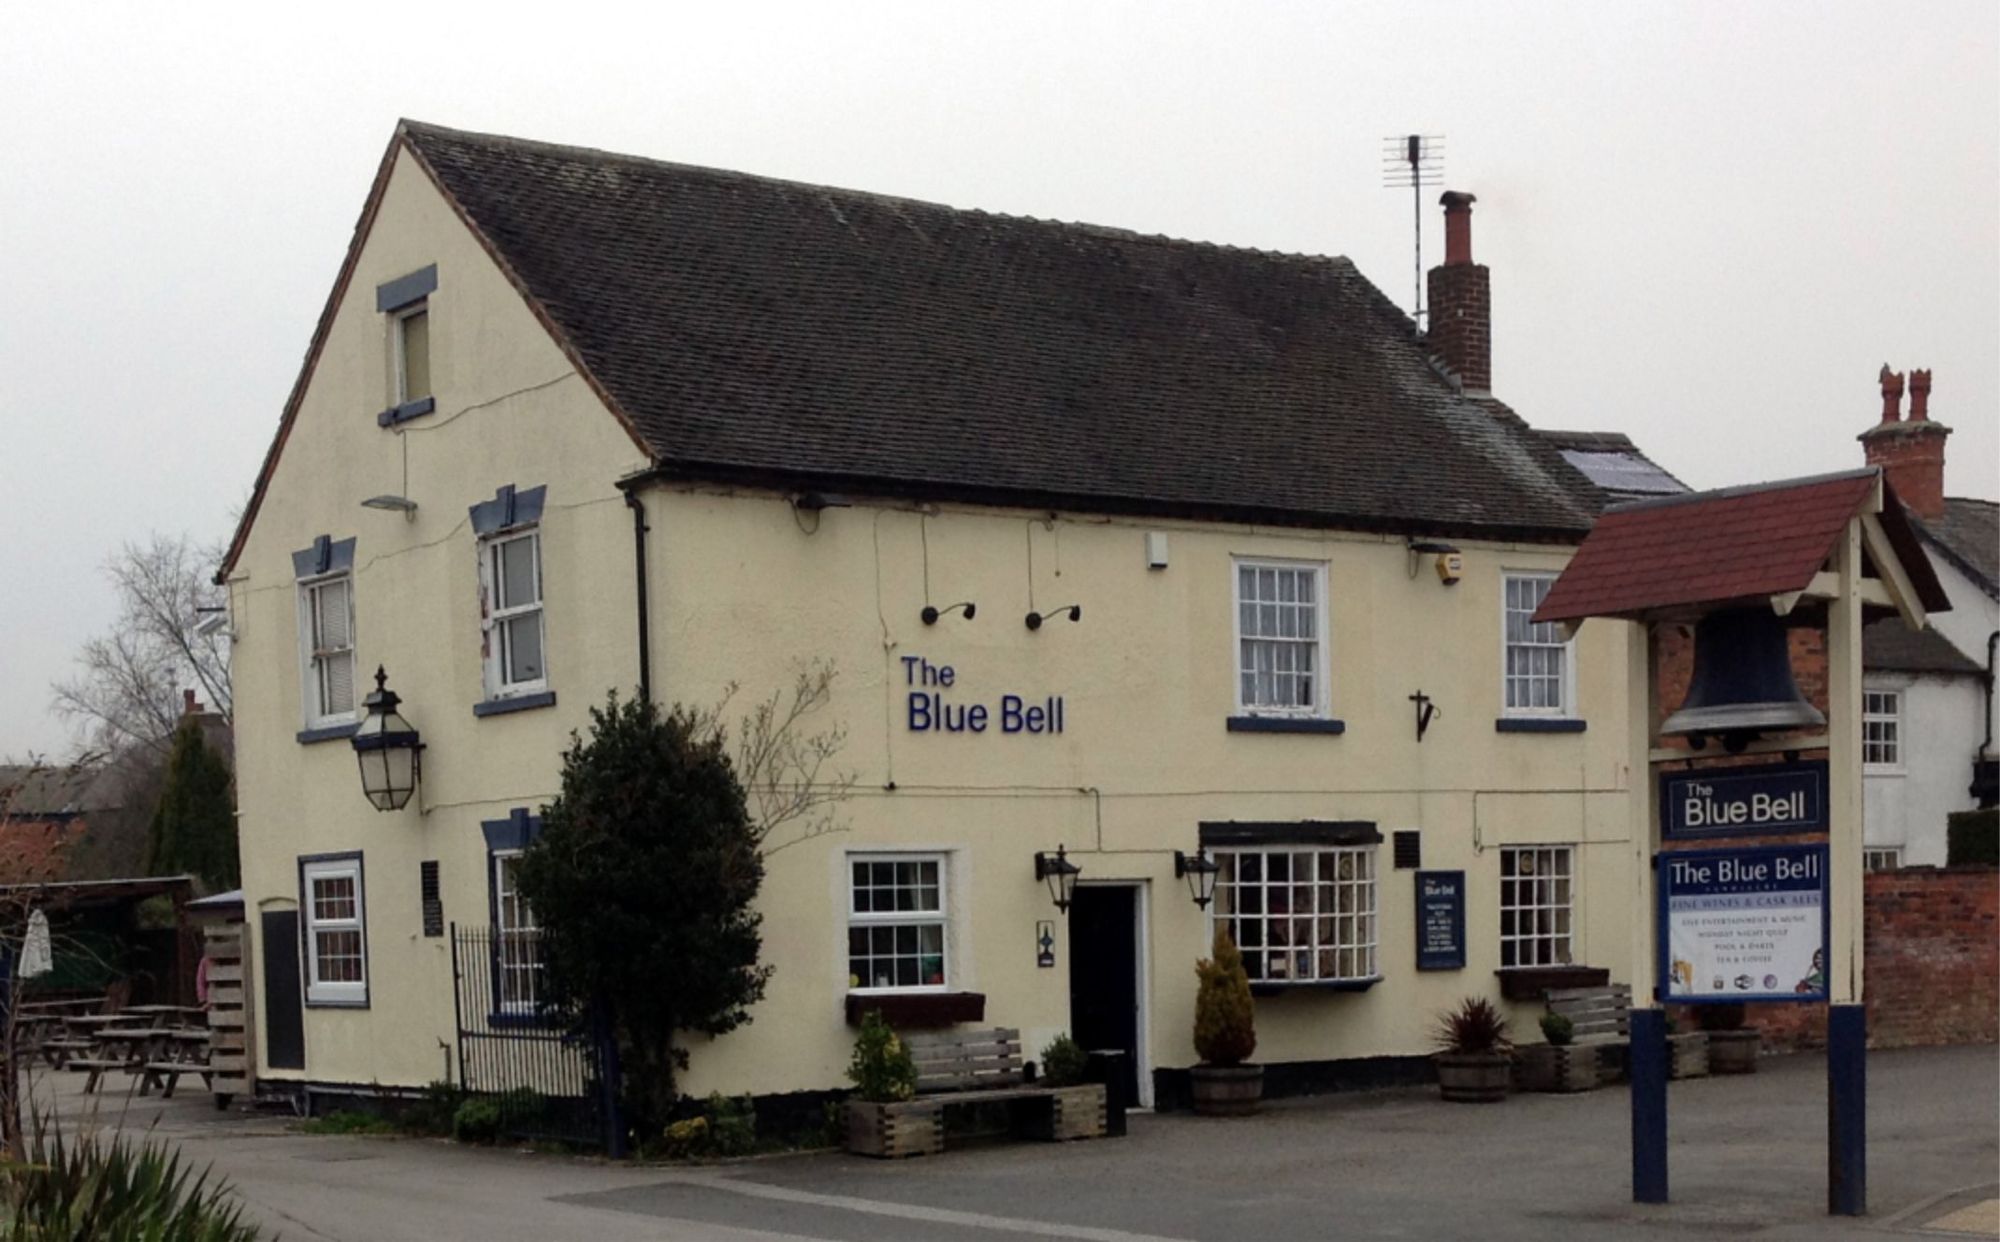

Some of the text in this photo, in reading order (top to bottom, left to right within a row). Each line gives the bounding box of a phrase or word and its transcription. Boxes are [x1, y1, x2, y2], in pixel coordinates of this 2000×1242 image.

[901, 656, 955, 687] The
[909, 692, 1063, 734] Blue Bell
[1686, 783, 1713, 797] The
[1685, 791, 1805, 826] Blue Bell
[1671, 854, 1818, 884] The Blue Bell
[1672, 899, 1697, 909] FINE
[1702, 898, 1739, 908] WINES
[1744, 898, 1752, 907] &
[1756, 896, 1787, 906] CASK
[1702, 917, 1768, 926] ENTERTAINMENT
